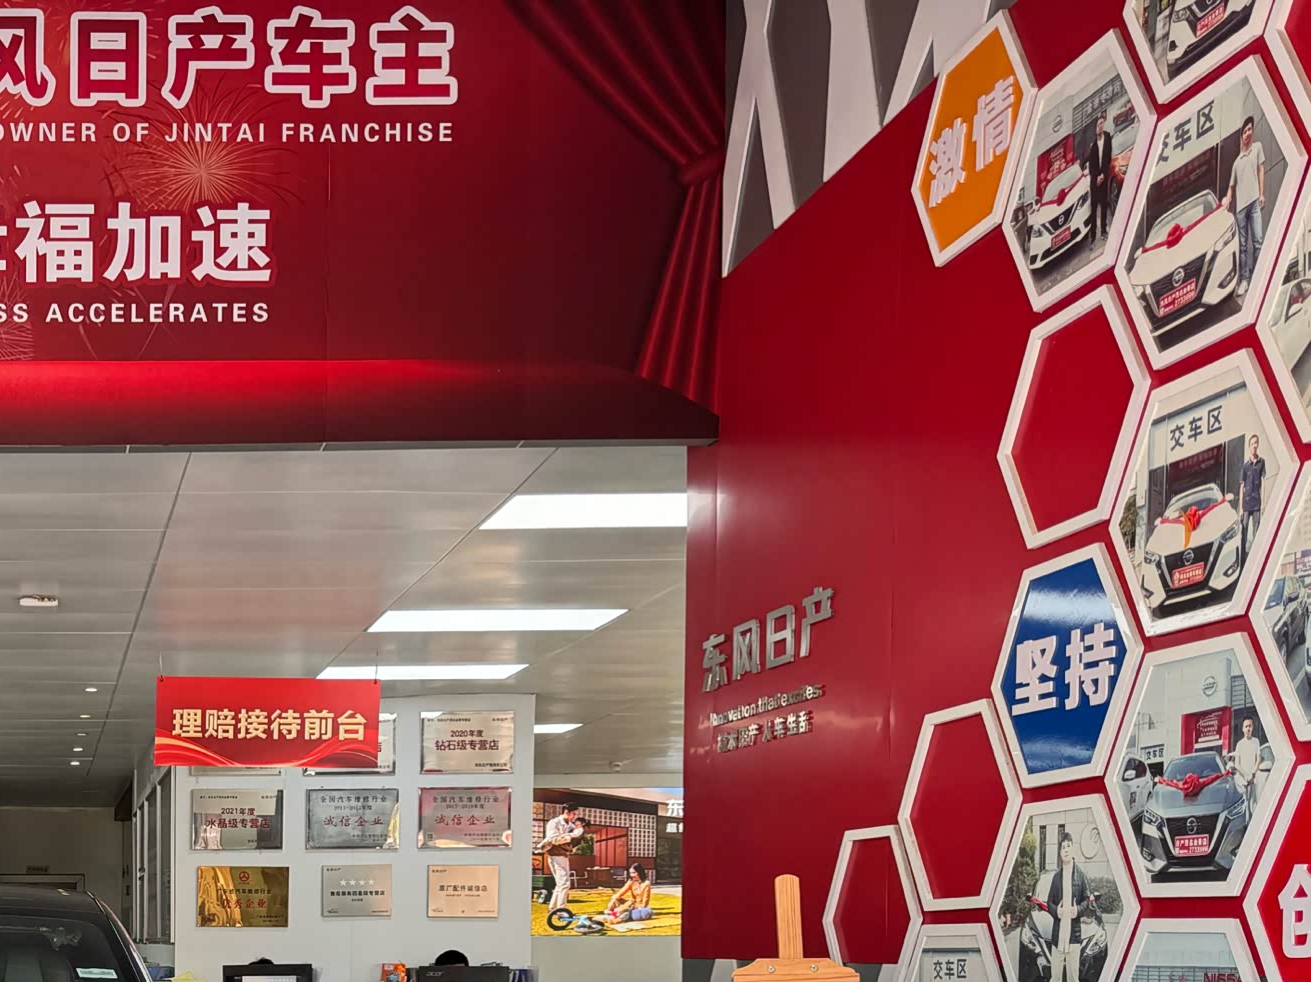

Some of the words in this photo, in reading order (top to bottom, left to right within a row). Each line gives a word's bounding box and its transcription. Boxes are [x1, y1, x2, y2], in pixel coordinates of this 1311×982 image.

[113, 122, 149, 143] OF
[165, 122, 265, 143] JINTAI
[282, 122, 453, 143] FRANCHISE
[929, 75, 1017, 207] 激情
[46, 303, 269, 323] ACCELERATES
[1170, 405, 1222, 451] 交车区
[702, 586, 835, 692] 东风日产
[1011, 622, 1119, 717] 坚持
[172, 708, 368, 741] 理赔接待前台
[450, 730, 484, 738] 2020年度
[435, 740, 499, 751] 钻石级专营店
[1146, 748, 1164, 760] 交车区
[221, 807, 255, 816] 2021年度
[323, 815, 384, 827] 诚信企业
[435, 814, 495, 826] 诚信企业
[206, 818, 270, 829] 水晶级专营店
[933, 959, 967, 980] 交车区
